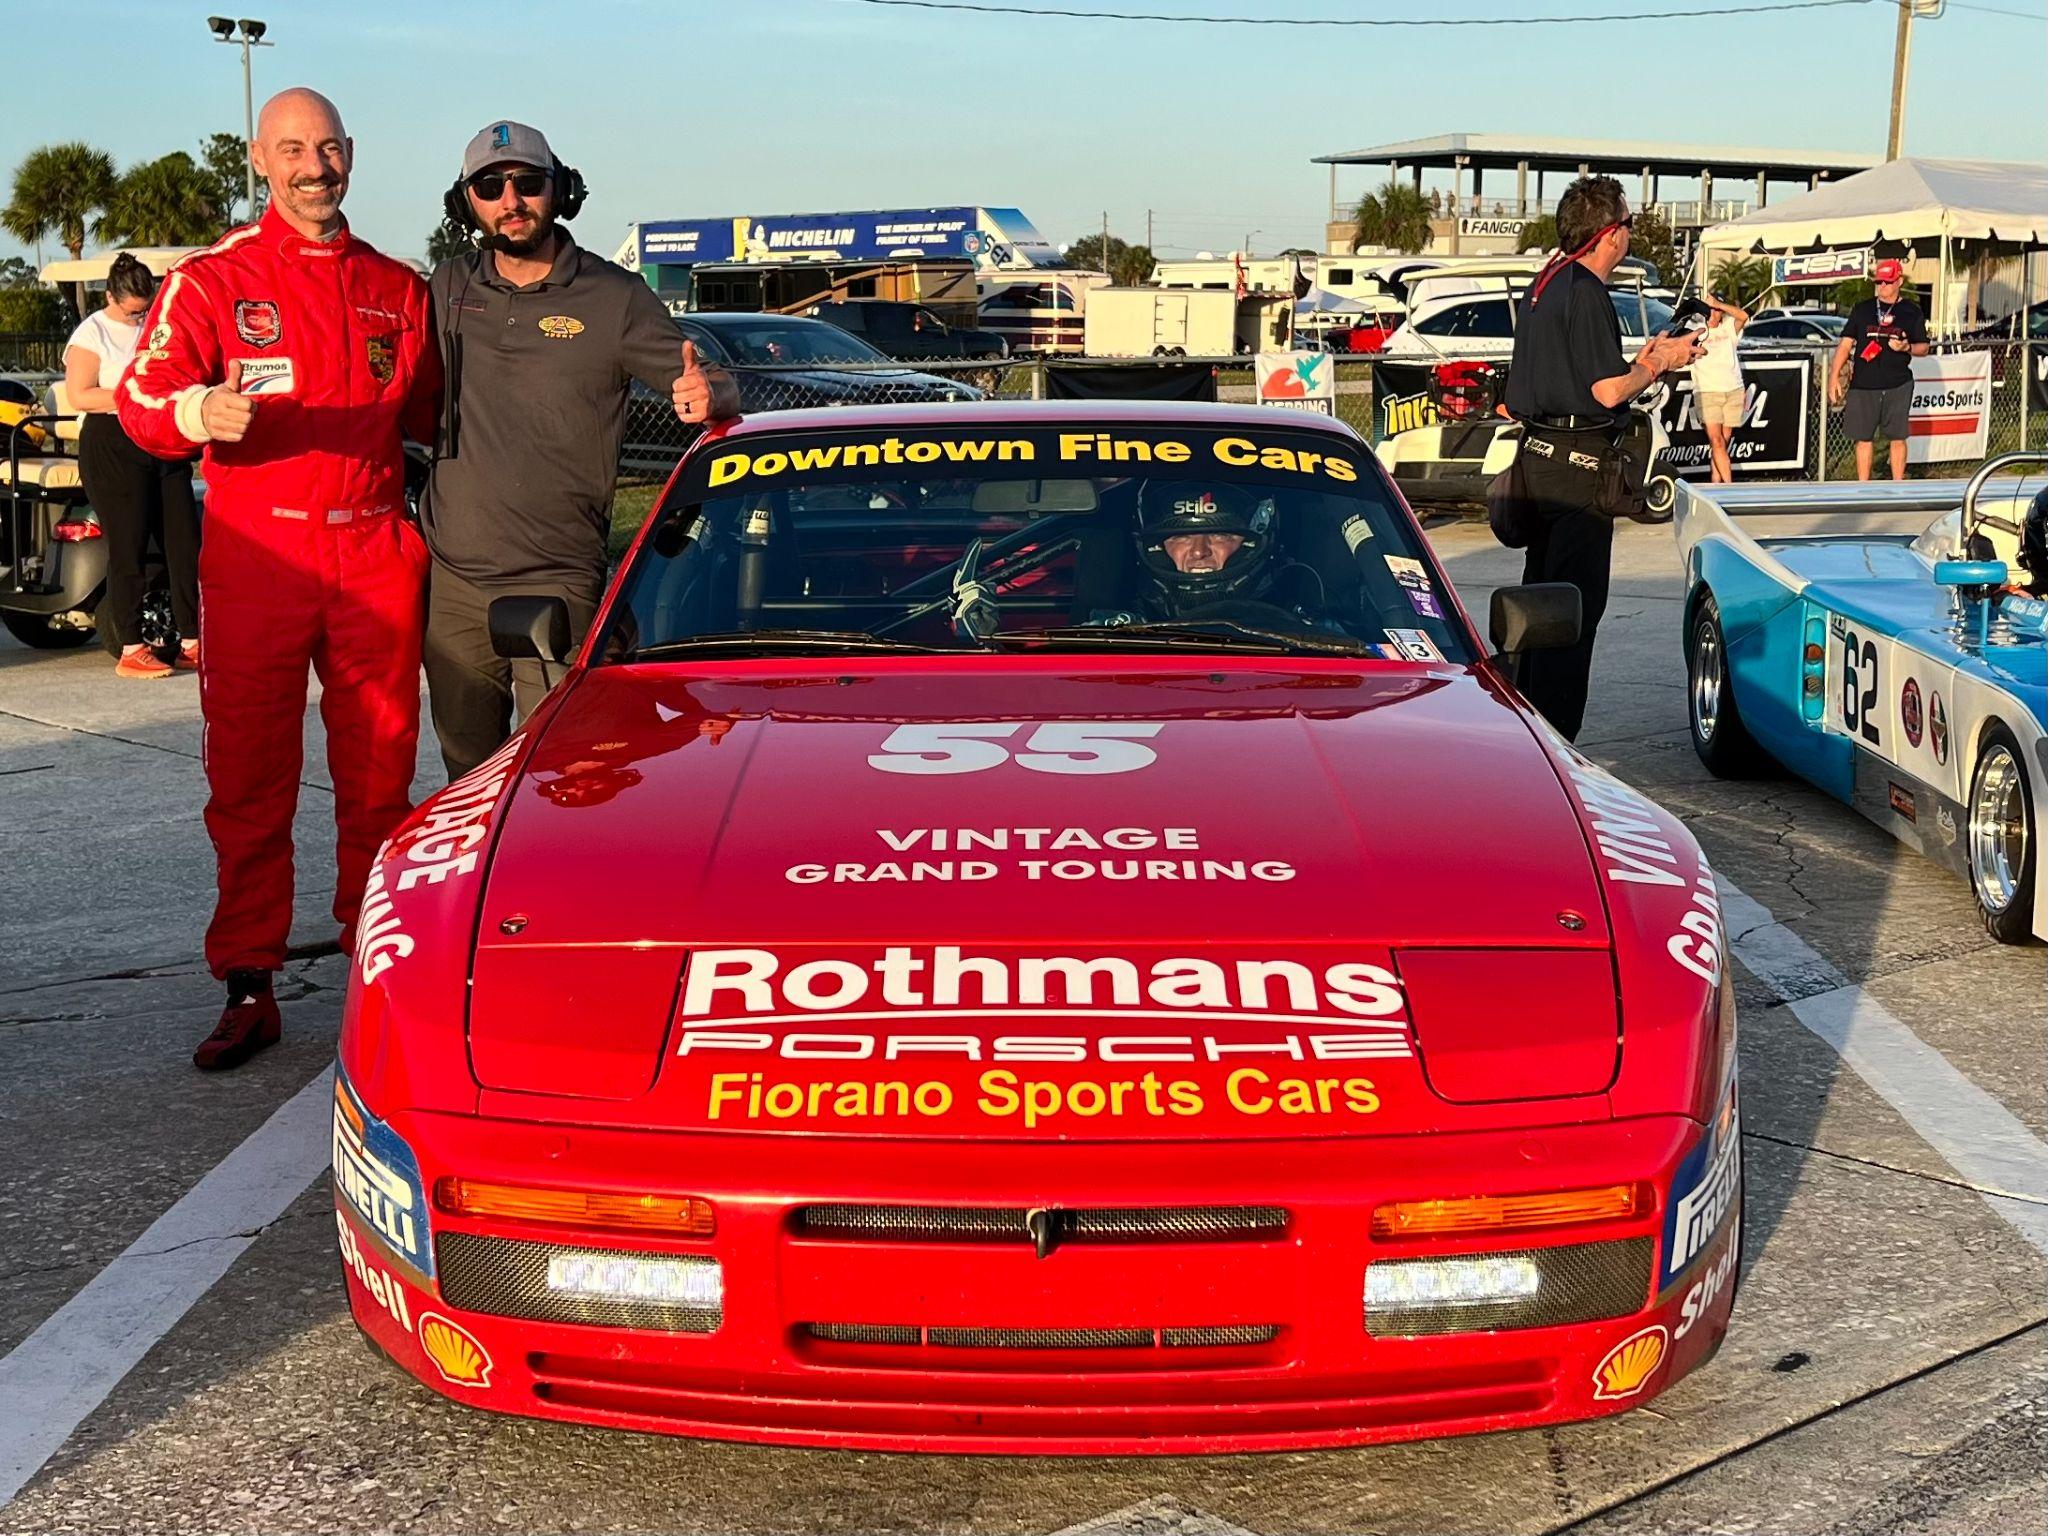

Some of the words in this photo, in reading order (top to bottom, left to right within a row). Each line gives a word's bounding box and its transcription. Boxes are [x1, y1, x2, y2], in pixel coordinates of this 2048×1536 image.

[769, 229, 855, 248] MICHELIN
[1471, 221, 1523, 234] FANGIO
[1784, 253, 1863, 277] HSR
[242, 363, 288, 373] Brumos
[1912, 389, 1984, 410] ascoSports
[708, 437, 1035, 488] Downtown
[1058, 433, 1192, 463] Fine
[1212, 437, 1358, 483] Cars
[1843, 631, 1880, 747] 62
[867, 722, 1165, 775] 55
[875, 827, 1200, 851] VINTAGE
[1557, 748, 1686, 887] VINTA
[784, 860, 999, 885] GRAND
[1018, 860, 1297, 881] TOURING
[683, 946, 1405, 1017] Rothmans
[677, 1031, 1414, 1063] PORSCHE
[707, 1071, 953, 1119] Fiorano
[977, 1068, 1204, 1128] Sports
[1225, 1067, 1381, 1115] Cars
[333, 1101, 417, 1256] PIRELLI
[1669, 1110, 1739, 1274] PIRELL
[336, 1209, 414, 1334] Shell
[1674, 1213, 1740, 1340] Shell
